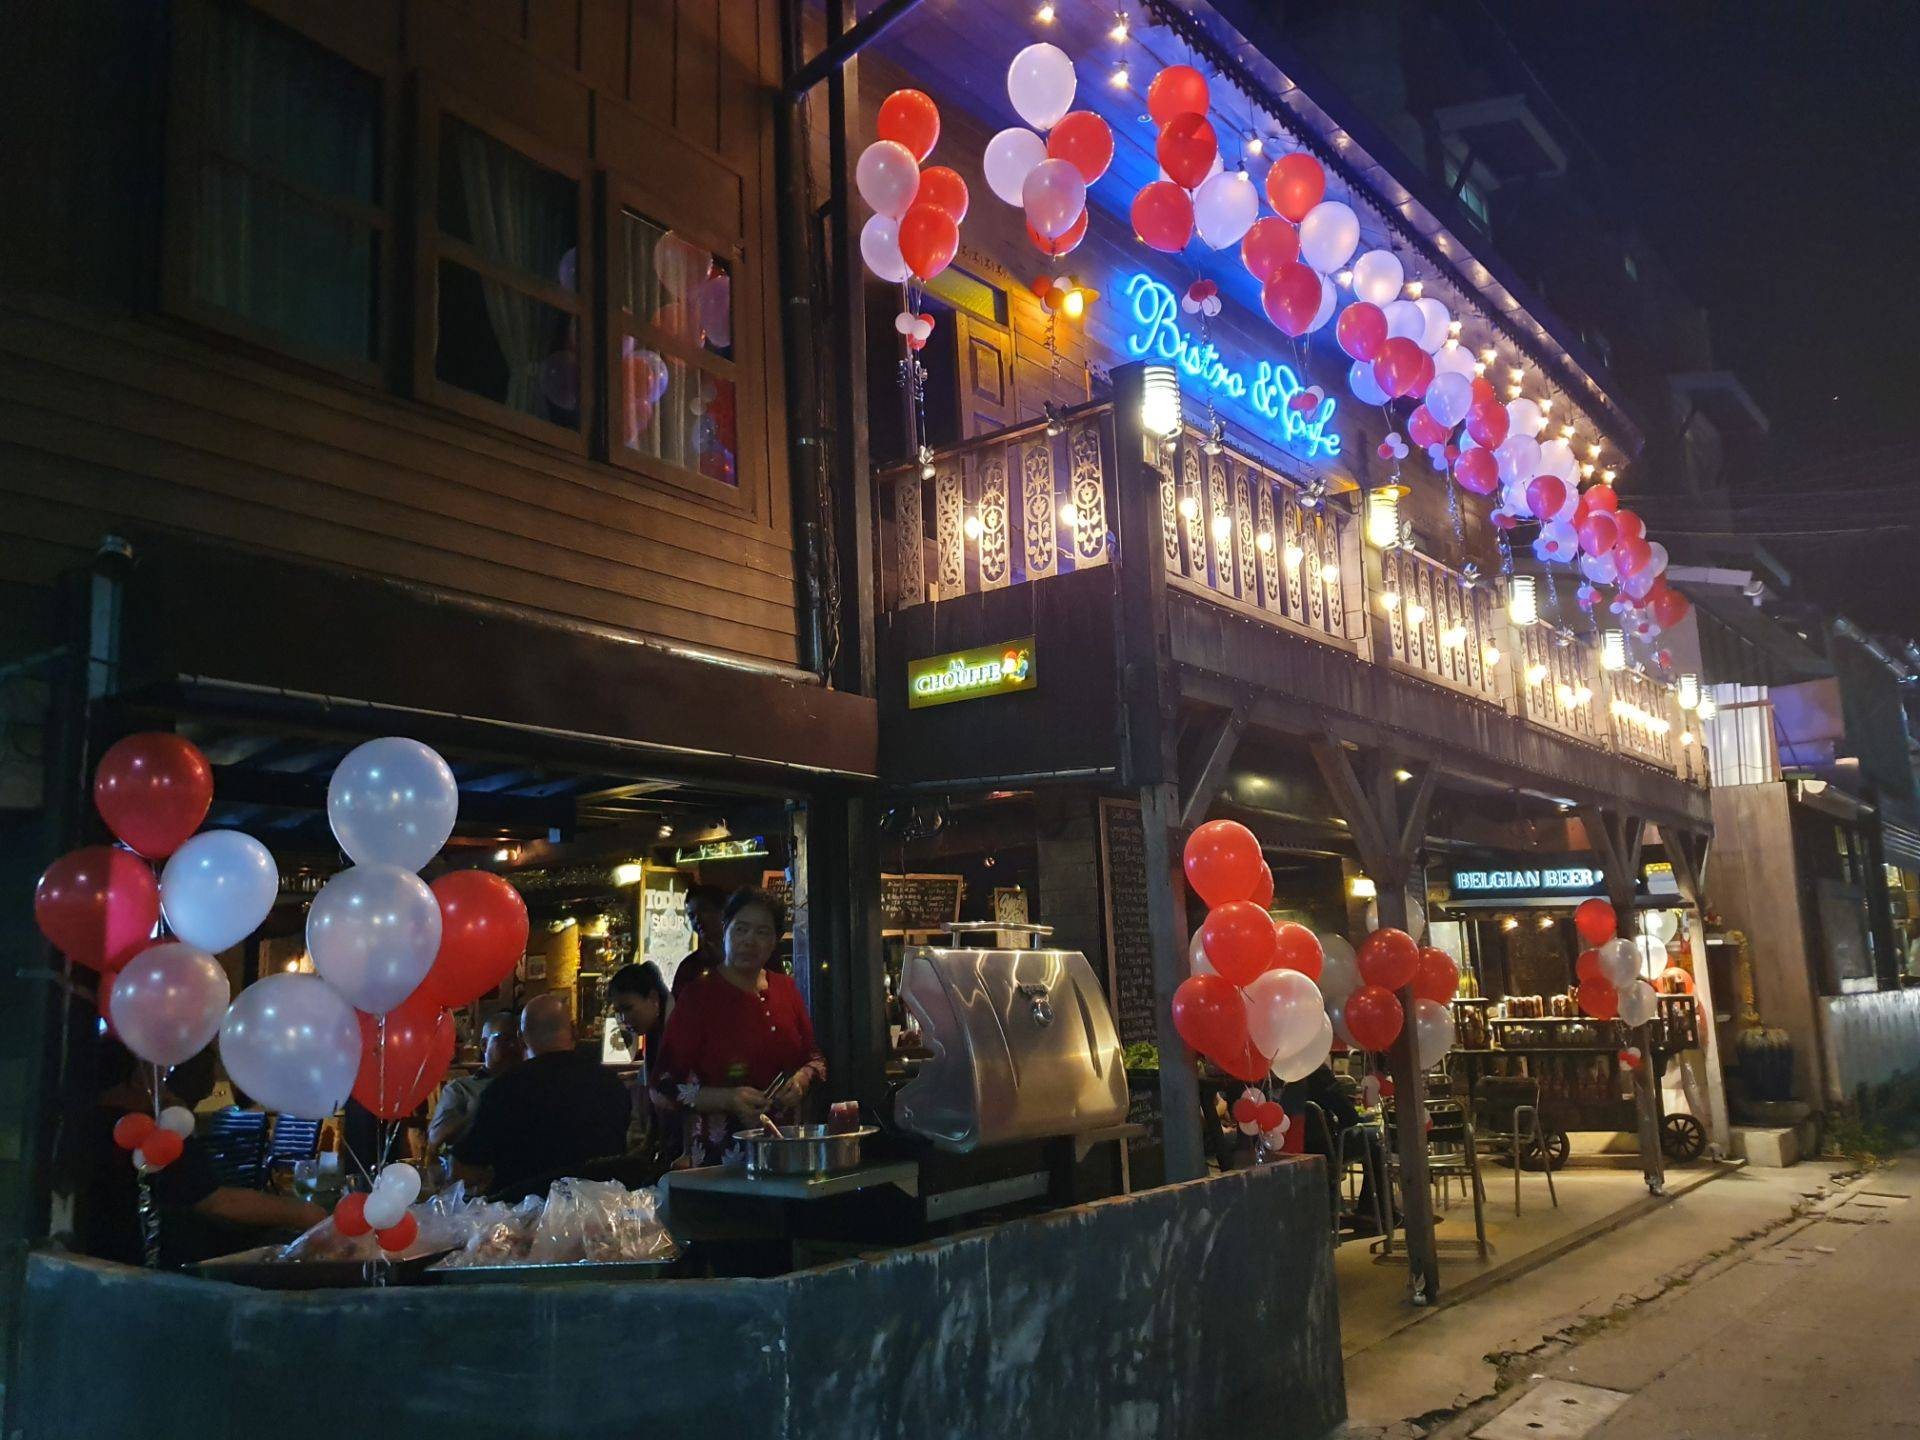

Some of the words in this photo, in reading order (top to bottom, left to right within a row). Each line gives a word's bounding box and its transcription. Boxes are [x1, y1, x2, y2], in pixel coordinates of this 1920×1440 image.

[1126, 272, 1247, 398] Bistro
[1252, 360, 1278, 418] &
[916, 662, 1001, 692] CHOUFFE
[950, 659, 964, 671] LA
[1456, 870, 1541, 890] BELGIAN
[1543, 868, 1594, 888] BEER
